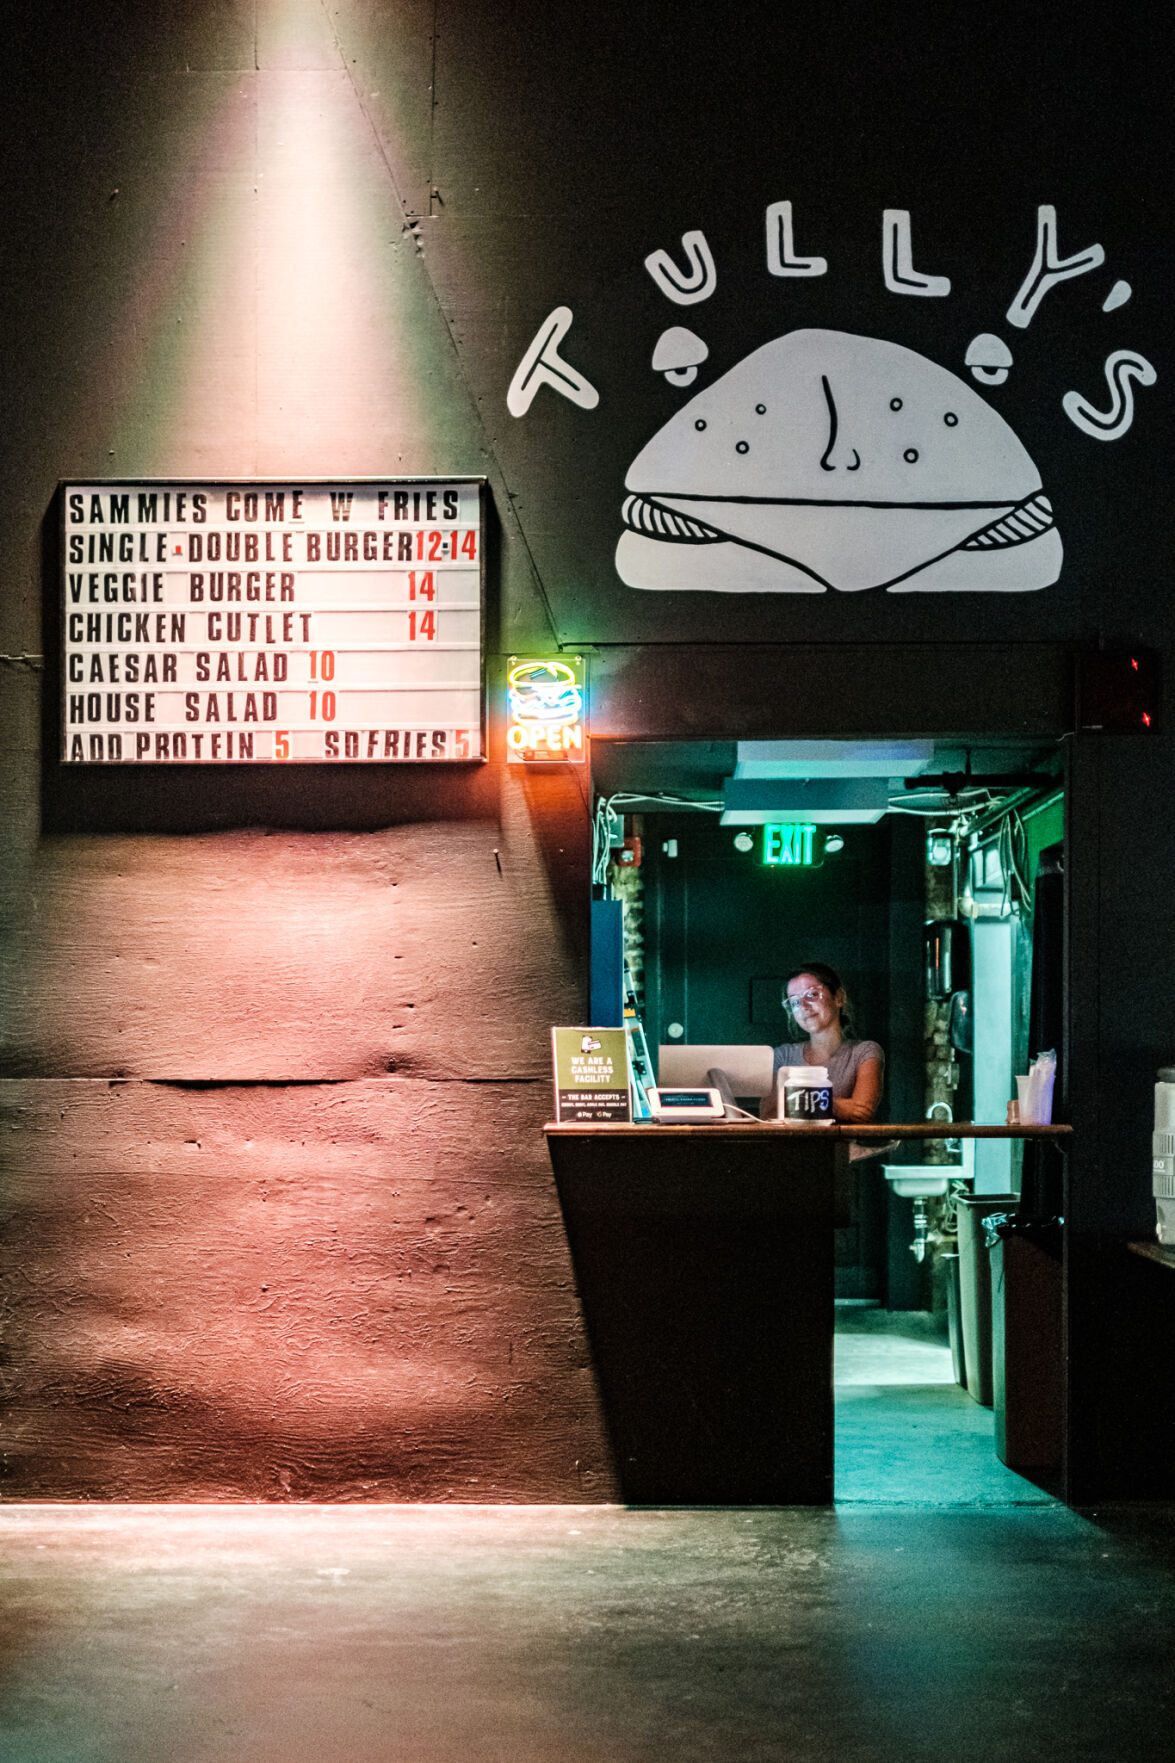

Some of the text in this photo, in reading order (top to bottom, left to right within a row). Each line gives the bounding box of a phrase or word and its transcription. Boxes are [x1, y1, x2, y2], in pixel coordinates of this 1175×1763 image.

[507, 200, 1157, 441] TULLY'S
[69, 490, 459, 524] SAMMIES COME W FRIES
[306, 530, 413, 563] BURGER
[69, 570, 436, 603] VEGGIE BURGER 14
[69, 610, 436, 644] CHICKEN CUTLET 14
[69, 650, 335, 683] CAESAR SALAD 10
[69, 690, 336, 724] HOUSE SALAD 10
[71, 732, 122, 760] ADD
[136, 731, 254, 760] PROTEIN
[275, 730, 290, 760] 5
[455, 730, 470, 759] 5
[507, 725, 582, 751] OPEN
[763, 823, 817, 865] EXIT
[571, 1056, 613, 1065] WE ARE A
[571, 1065, 614, 1074] CASHLESS
[574, 1074, 611, 1083] FACILITY
[787, 1089, 830, 1113] TIPS
